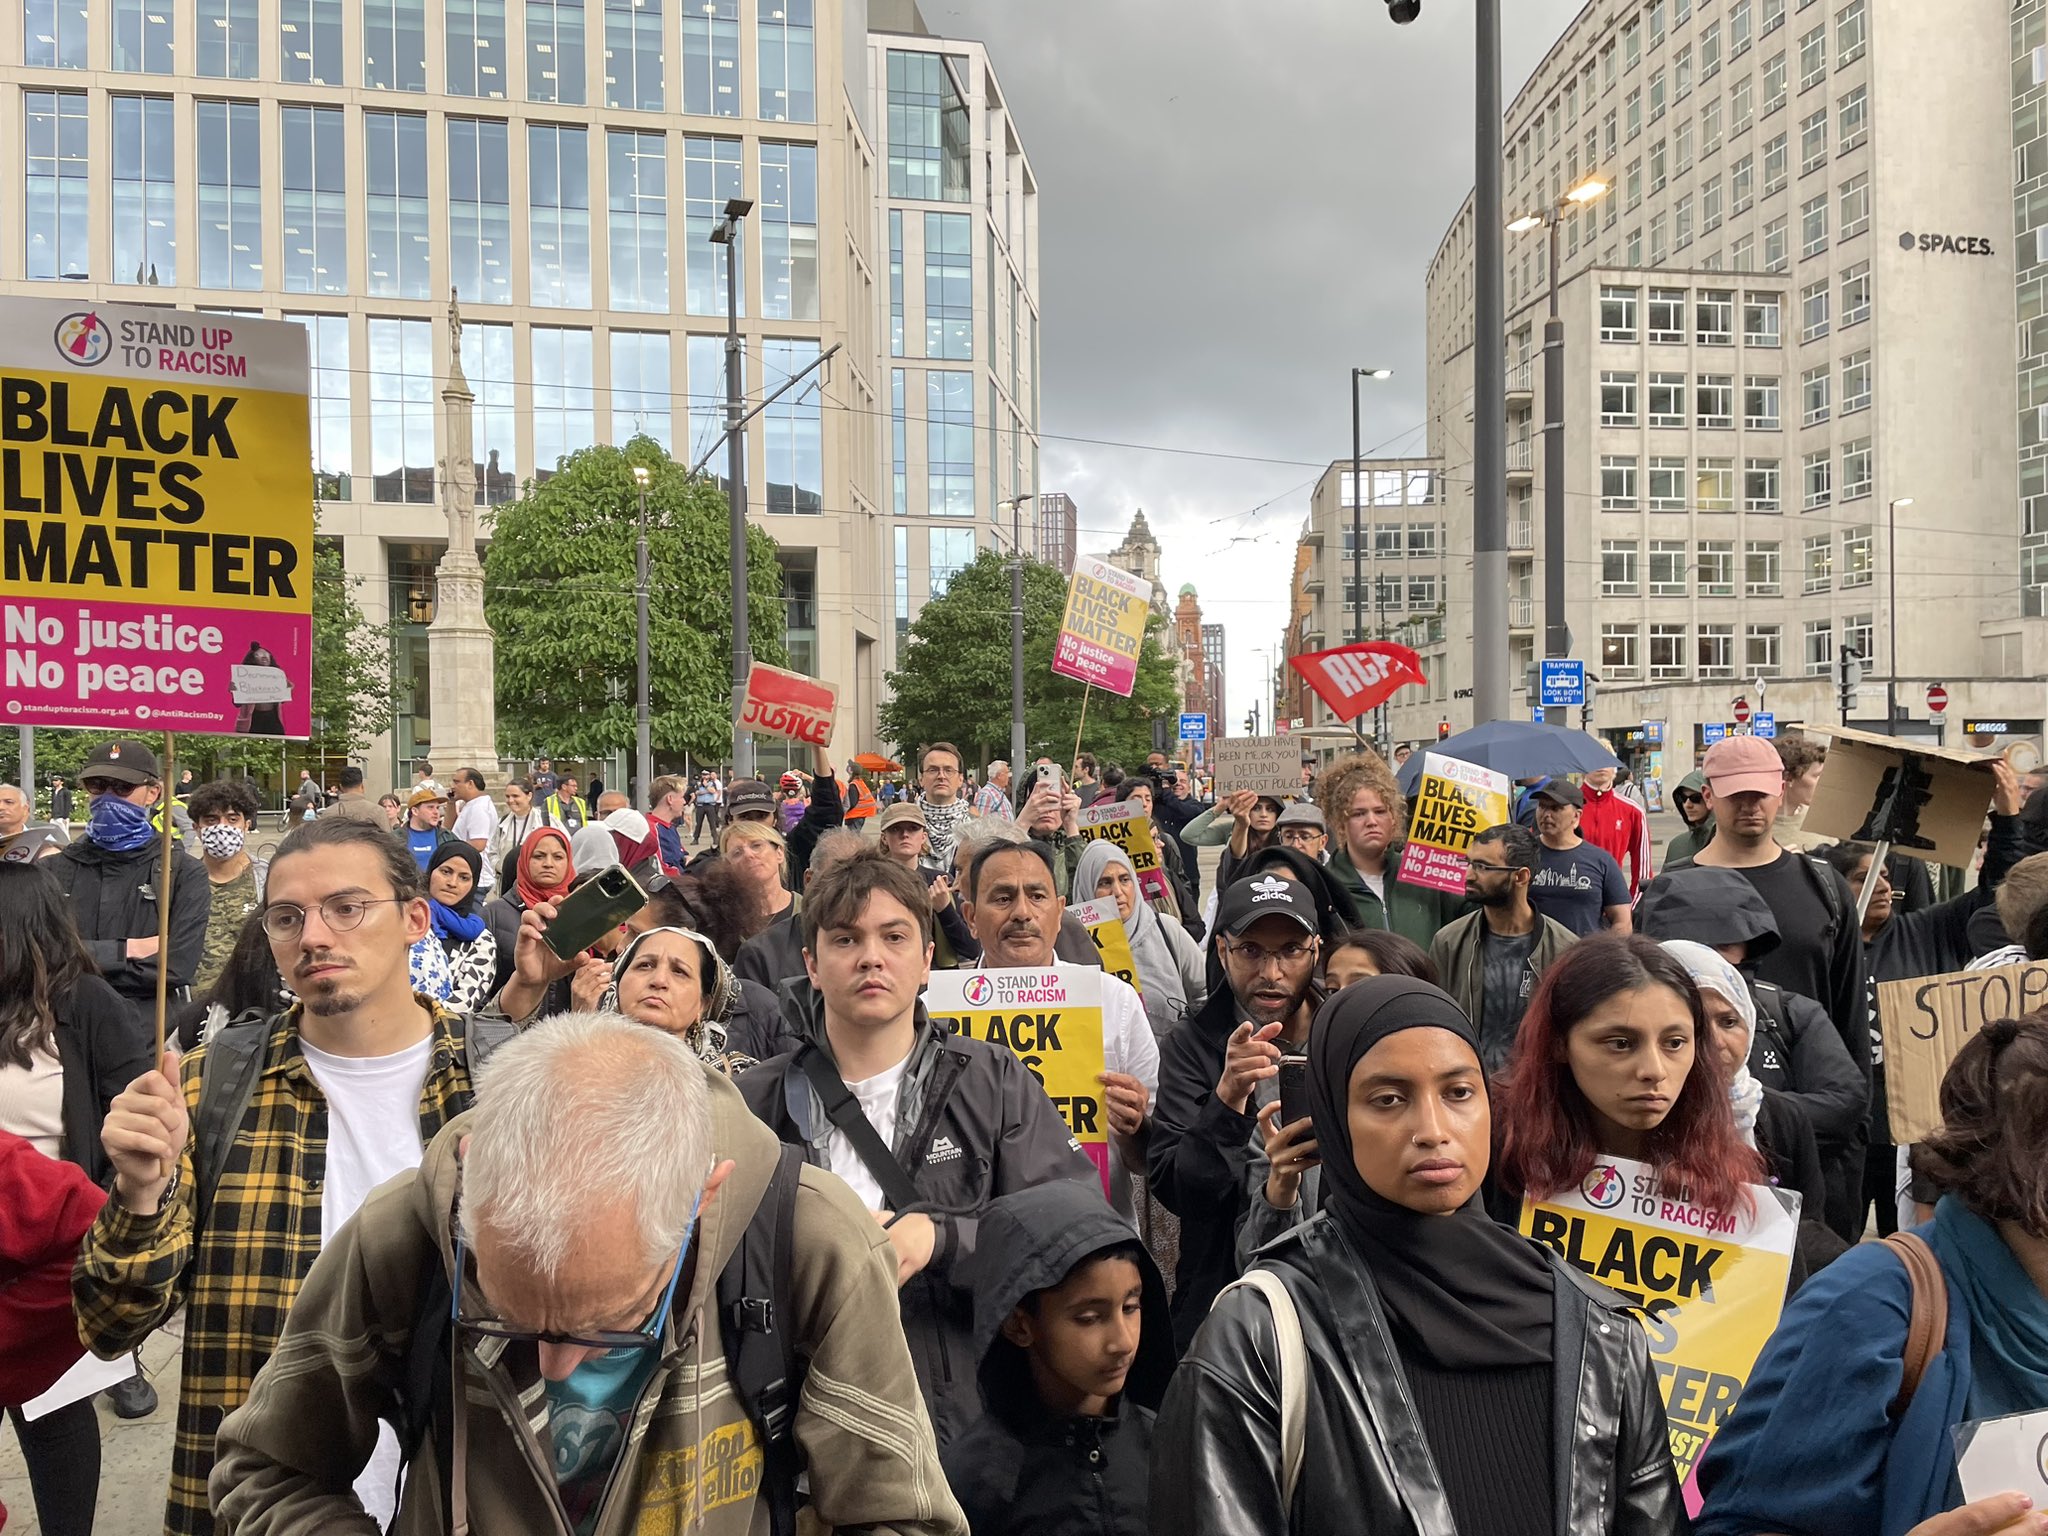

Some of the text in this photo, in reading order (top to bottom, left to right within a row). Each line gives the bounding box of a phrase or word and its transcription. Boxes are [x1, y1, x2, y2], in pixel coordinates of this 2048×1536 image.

[121, 320, 233, 351] STAND UP
[121, 346, 247, 377] TO RACISM
[1, 377, 239, 459] BLACK
[3, 448, 205, 524] LIVES
[4, 518, 298, 598] MATTER
[1075, 575, 1131, 614] BLACK
[1071, 594, 1119, 628] LIVES
[5, 605, 223, 656] No justice
[1067, 612, 1136, 655] MATTER
[1059, 648, 1074, 662] No
[1075, 655, 1107, 675] peace
[1063, 635, 1114, 665] No justice
[5, 649, 204, 699] No peace
[1458, 688, 1473, 698] SPACE
[23, 703, 224, 721] standuptoracism.org.uk @AntiRacismDay
[743, 699, 830, 744] JUSTICE
[1974, 723, 2008, 732] GREGGS
[1218, 737, 1296, 748] THIS COULD HAVE
[1219, 751, 1240, 761] BEEN
[1233, 762, 1280, 777] DEFUND
[1217, 780, 1233, 791] THE
[1236, 779, 1270, 791] RACIST
[1424, 778, 1490, 811] BLACK
[1100, 806, 1117, 815] STAND
[1110, 811, 1130, 820] RACISM
[1419, 799, 1478, 828] LIVES
[1413, 820, 1478, 849] MATT
[1404, 859, 1422, 872] No
[1424, 864, 1462, 881] peace
[1408, 845, 1467, 870] No justi
[1252, 889, 1293, 902] adidas
[1081, 913, 1100, 924] CISM
[1082, 905, 1093, 915] UP
[997, 974, 1059, 989] STAND UP
[997, 989, 1066, 1004] TO RACISM
[1910, 967, 2048, 1040] STOP
[926, 1147, 962, 1160] MOUNTAIN
[1631, 1195, 1737, 1234] TO RACISM
[1531, 1208, 1724, 1304] BLACK
